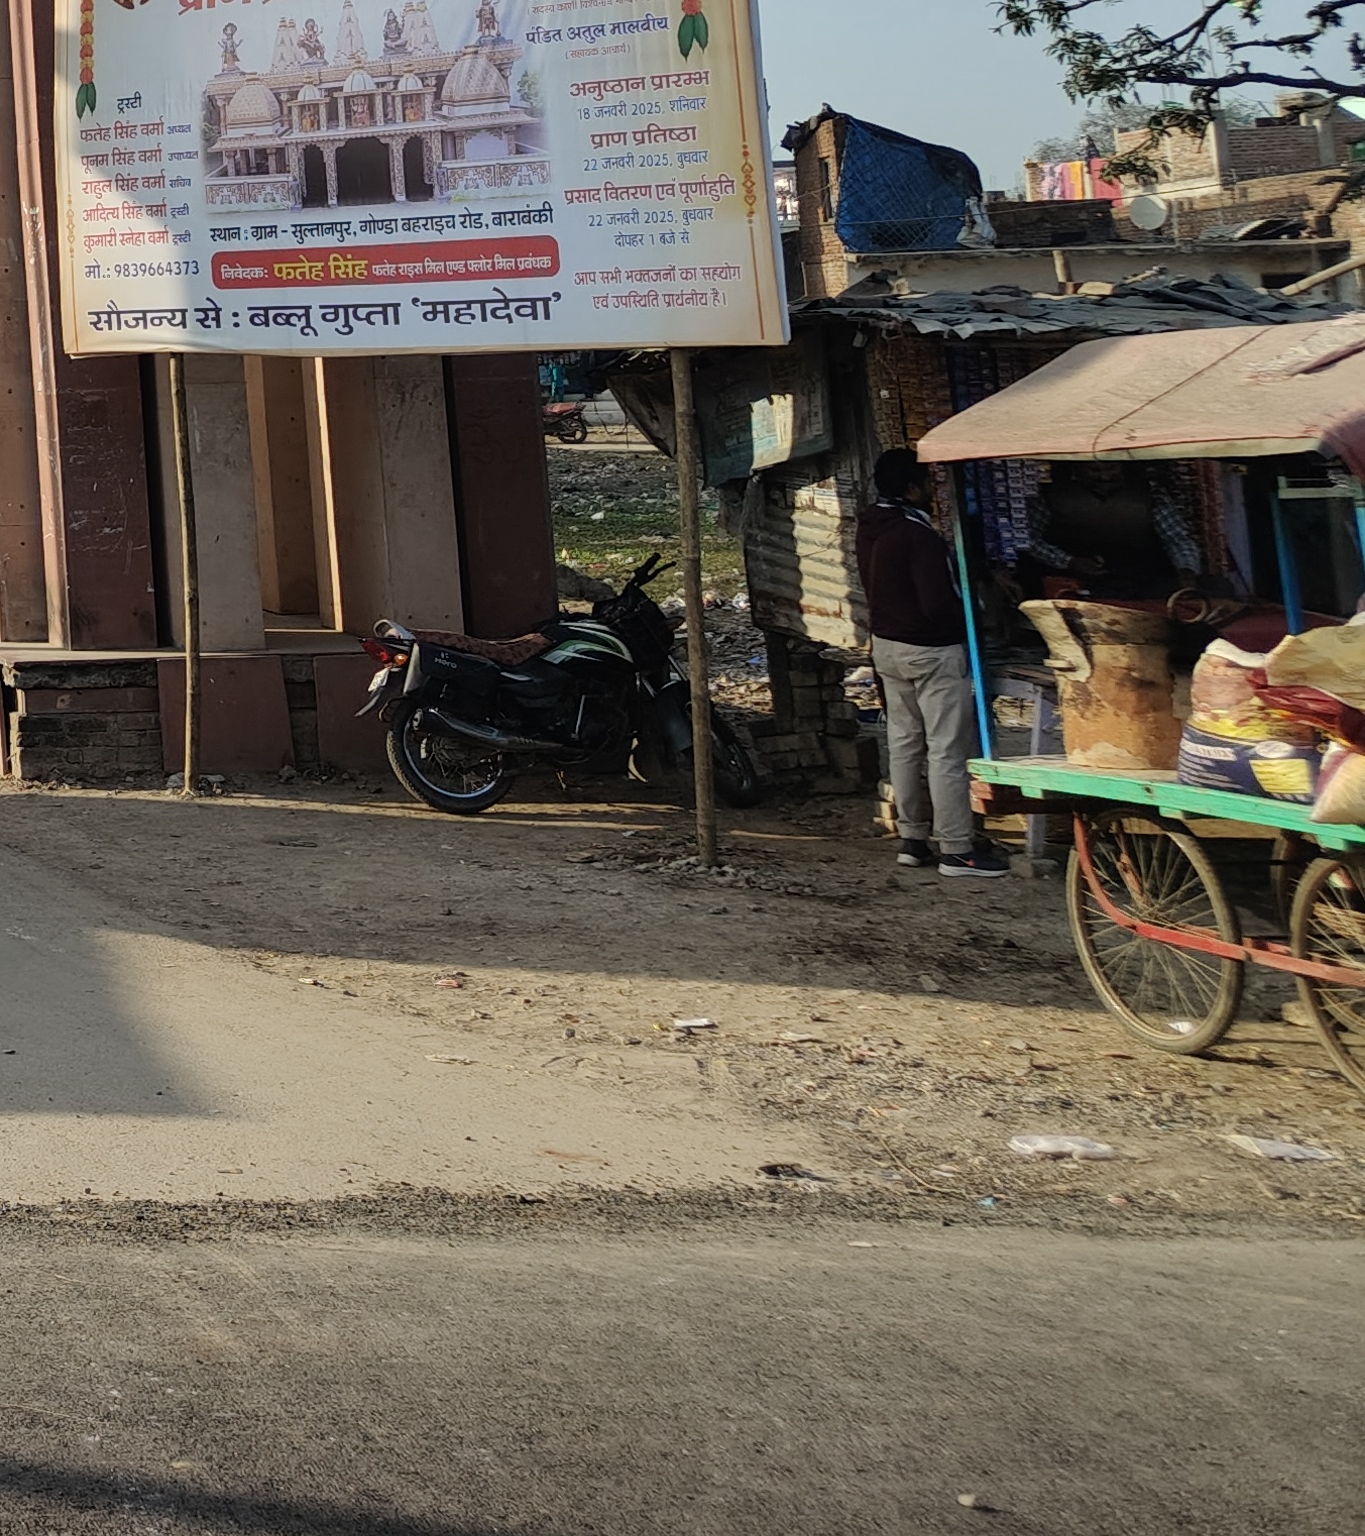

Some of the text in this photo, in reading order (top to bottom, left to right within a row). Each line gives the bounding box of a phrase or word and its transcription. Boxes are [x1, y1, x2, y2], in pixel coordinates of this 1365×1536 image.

[526, 13, 669, 44] पंडित अतुल मालवीय
[570, 70, 710, 101] अनुष्ठान प्रारम्भ
[578, 108, 591, 120] 18
[593, 101, 627, 119] जनवरी
[669, 96, 706, 112] शनिवार
[80, 122, 111, 142] फतेह
[114, 120, 137, 139] सिंह
[140, 116, 164, 136] वर्मा
[591, 123, 697, 149] प्राण प्रतिष्ठा
[81, 154, 109, 174] पूनम
[112, 146, 135, 166] सिंह
[138, 142, 162, 163] वर्मा
[583, 159, 598, 171] 22
[601, 152, 634, 170] जनवरी
[676, 150, 708, 169] बुधवार
[81, 179, 112, 199] राहुल
[115, 173, 138, 192] सिंह
[141, 168, 166, 189] वर्मा
[564, 173, 735, 205] प्रसाद वितरण एवं पूर्णाहुति
[83, 202, 119, 222] आदित्य
[121, 200, 143, 219] सिंह
[145, 197, 167, 217] वर्मा
[251, 225, 278, 241] ग्राम
[359, 212, 399, 236] गोण्डा
[401, 213, 456, 236] बहराइच
[491, 201, 554, 226] बाराबंकी
[588, 215, 603, 227] 22
[606, 208, 639, 226] जनवरी
[681, 207, 713, 225] बुधवार
[84, 227, 117, 253] कुमारी
[119, 227, 145, 246] स्नेहा
[147, 225, 169, 244] वर्मा
[614, 228, 690, 248] दोपहर 1 बजे से
[114, 260, 200, 278] 9839664373
[273, 254, 324, 281] फतेह
[328, 253, 368, 280] सिंह
[371, 259, 397, 277] फतेह
[424, 257, 444, 275] मिल
[493, 253, 515, 271] मिल
[574, 262, 741, 285] आप सभी भक्तजनों का सहयोग
[593, 293, 608, 309] एवं
[612, 290, 659, 309] उपस्थिति
[88, 299, 188, 331] सौजन्य
[194, 297, 222, 329] से
[247, 305, 319, 337] बब्लू
[319, 302, 401, 336] गुप्ता
